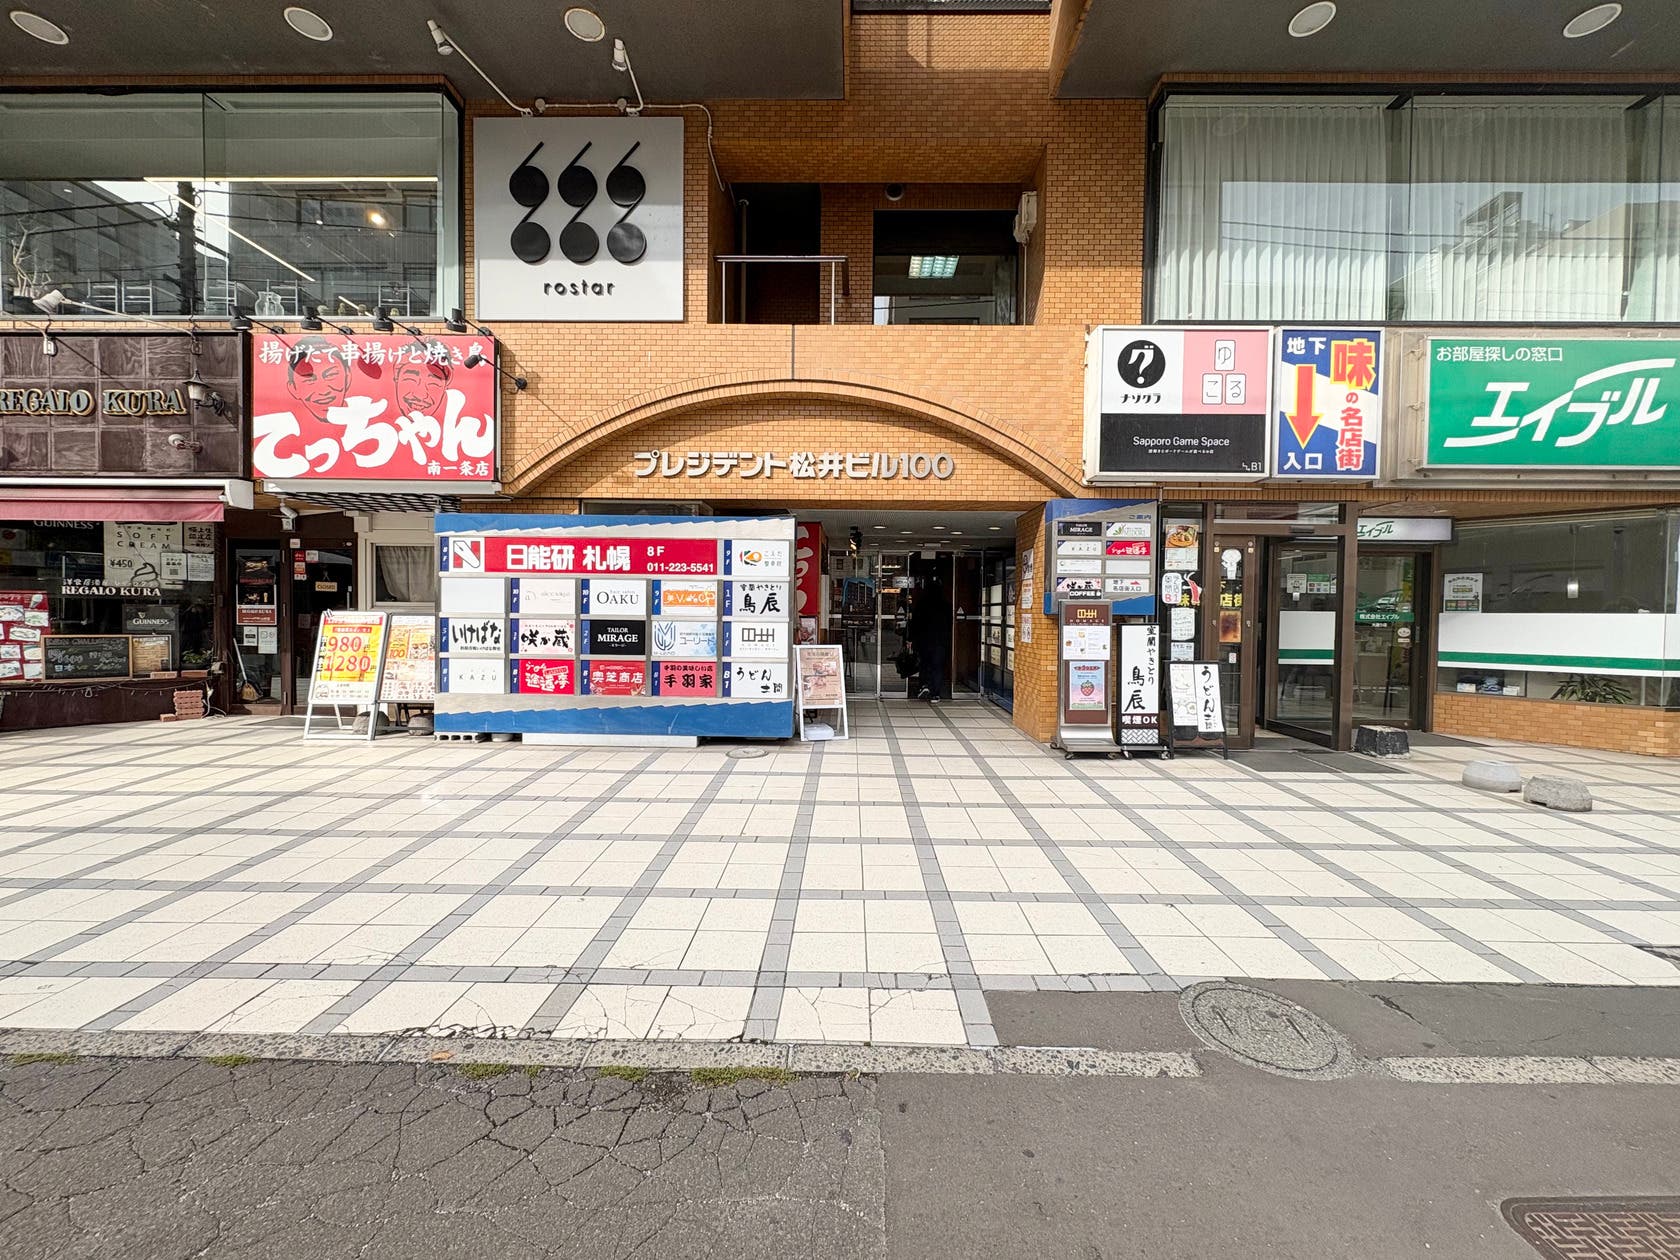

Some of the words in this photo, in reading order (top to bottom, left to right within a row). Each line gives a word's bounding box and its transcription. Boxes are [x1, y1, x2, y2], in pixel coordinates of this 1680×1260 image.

[543, 279, 616, 296] rostar
[1287, 337, 1327, 355] 地下
[1436, 346, 1564, 362] お部屋探しの窓口
[1217, 346, 1233, 365] ゆ
[0, 388, 94, 417] REGALO
[102, 388, 187, 418] KURA
[1330, 338, 1376, 470] 味の名店街
[1443, 358, 1677, 448] エイブル
[253, 388, 495, 478] てっちゃん
[1133, 437, 1171, 447] Sapporo
[1173, 437, 1199, 446] Game
[1201, 437, 1231, 447] Space
[427, 460, 489, 476] 南一条店
[633, 450, 954, 479] プレジデント松井ビル100
[1251, 461, 1262, 472] B1
[1283, 452, 1323, 470] 入口
[116, 531, 171, 541] SOFT
[1358, 520, 1394, 538] エイブル
[506, 545, 574, 570] 日能研
[582, 546, 630, 571] 札幌
[647, 546, 665, 556] 8F
[110, 560, 133, 568] ¥450
[647, 563, 714, 572] 011-223-5541
[61, 586, 117, 595] REGALO
[120, 586, 162, 596] KURA
[596, 592, 639, 604] OAKU
[452, 620, 502, 644] いけばな
[597, 634, 638, 642] MIRAGE
[328, 636, 362, 652] 980
[324, 655, 371, 672] 1280
[591, 671, 643, 684] 奥芝商店
[663, 674, 713, 688] 手羽家
[737, 667, 772, 681] うどん
[1201, 666, 1215, 712] うどん
[1121, 715, 1158, 725] 喫煙OK
